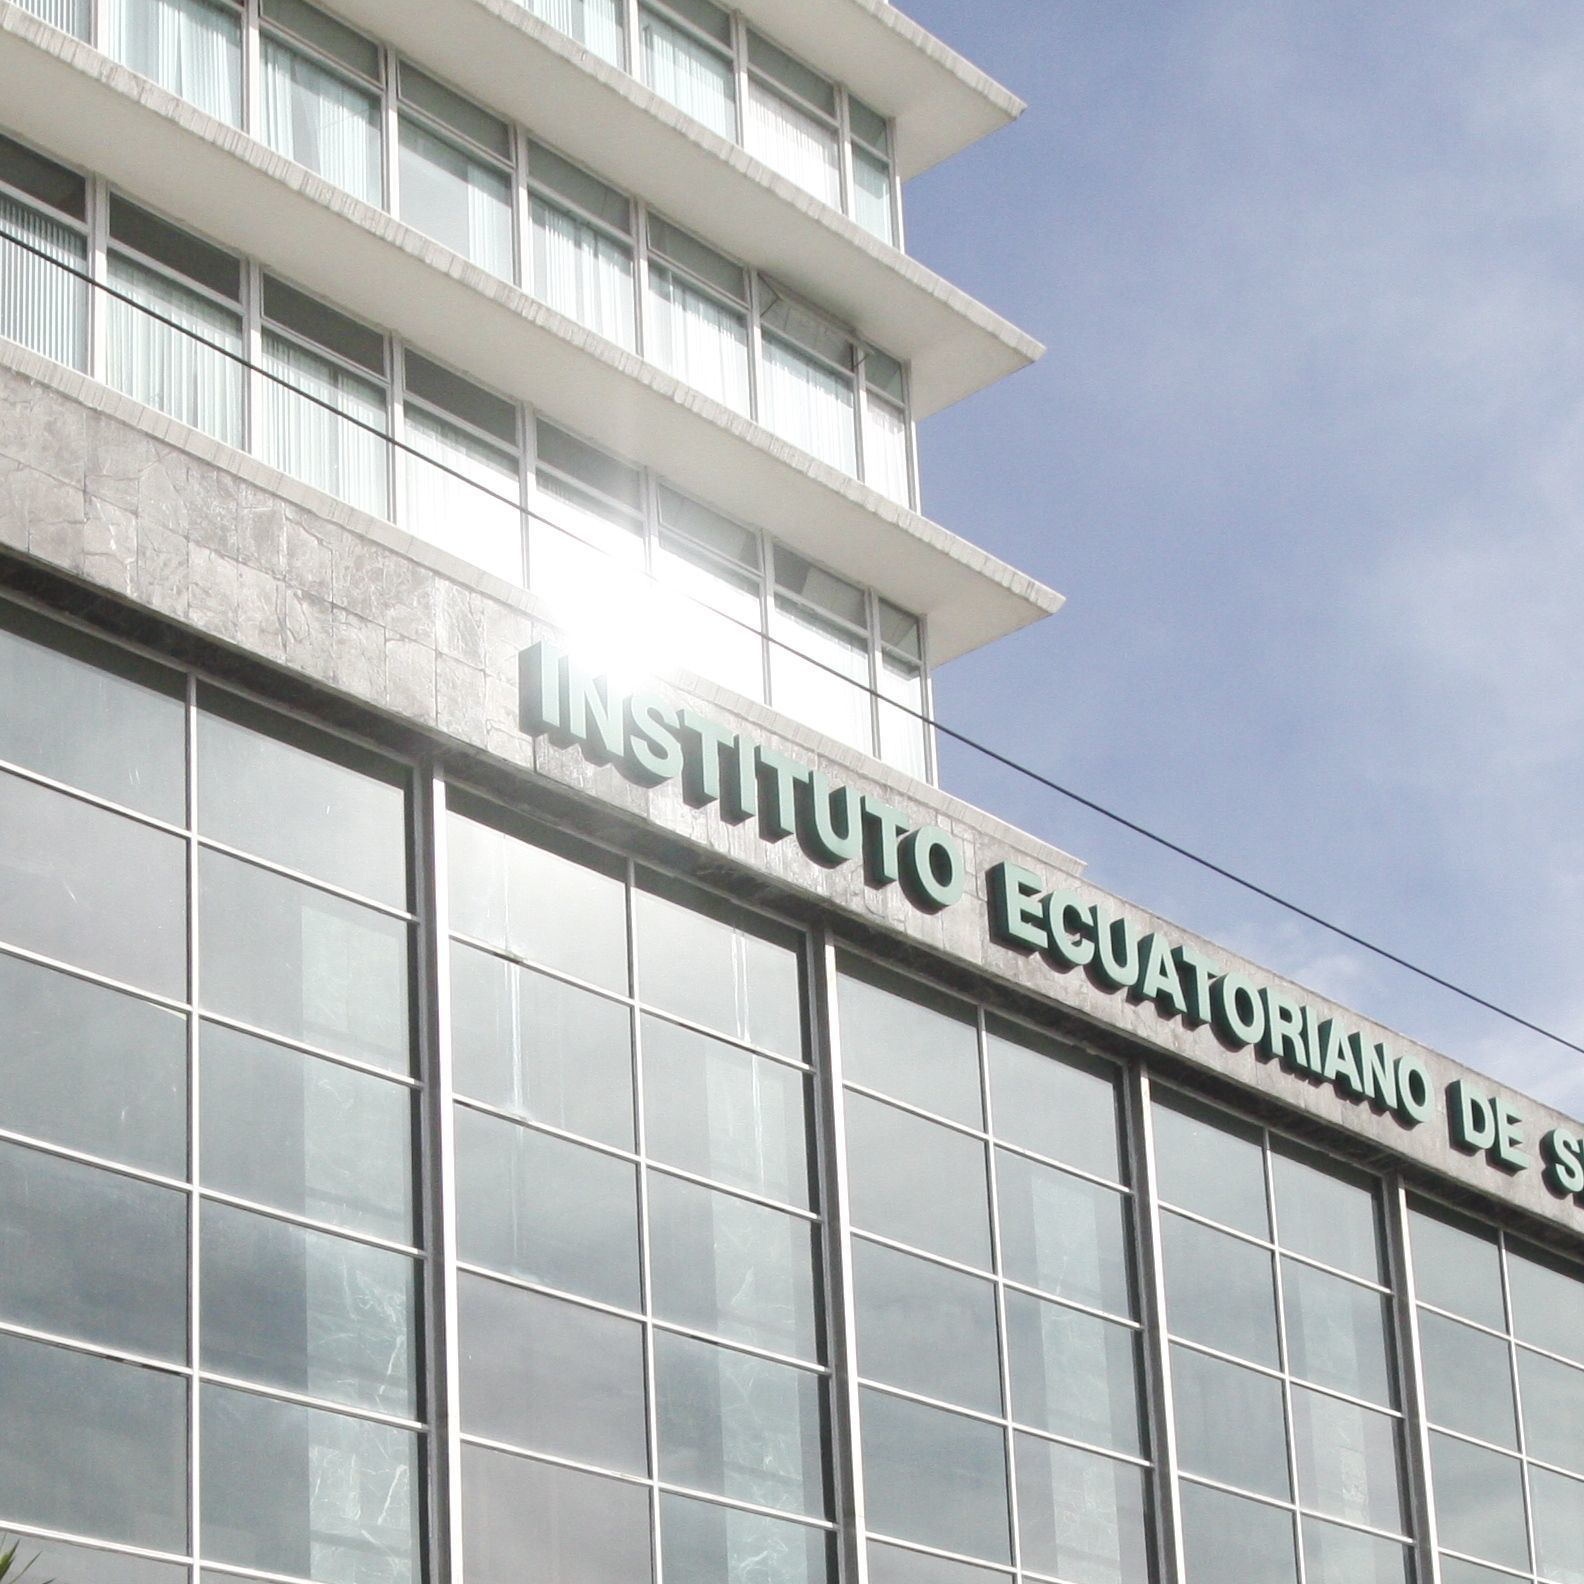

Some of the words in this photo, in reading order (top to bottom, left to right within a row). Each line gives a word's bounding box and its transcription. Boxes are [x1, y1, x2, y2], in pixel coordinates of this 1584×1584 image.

[521, 640, 965, 910] INSTITUTO
[989, 861, 1433, 1124] ECUATORIANO
[1448, 1079, 1529, 1171] DE
